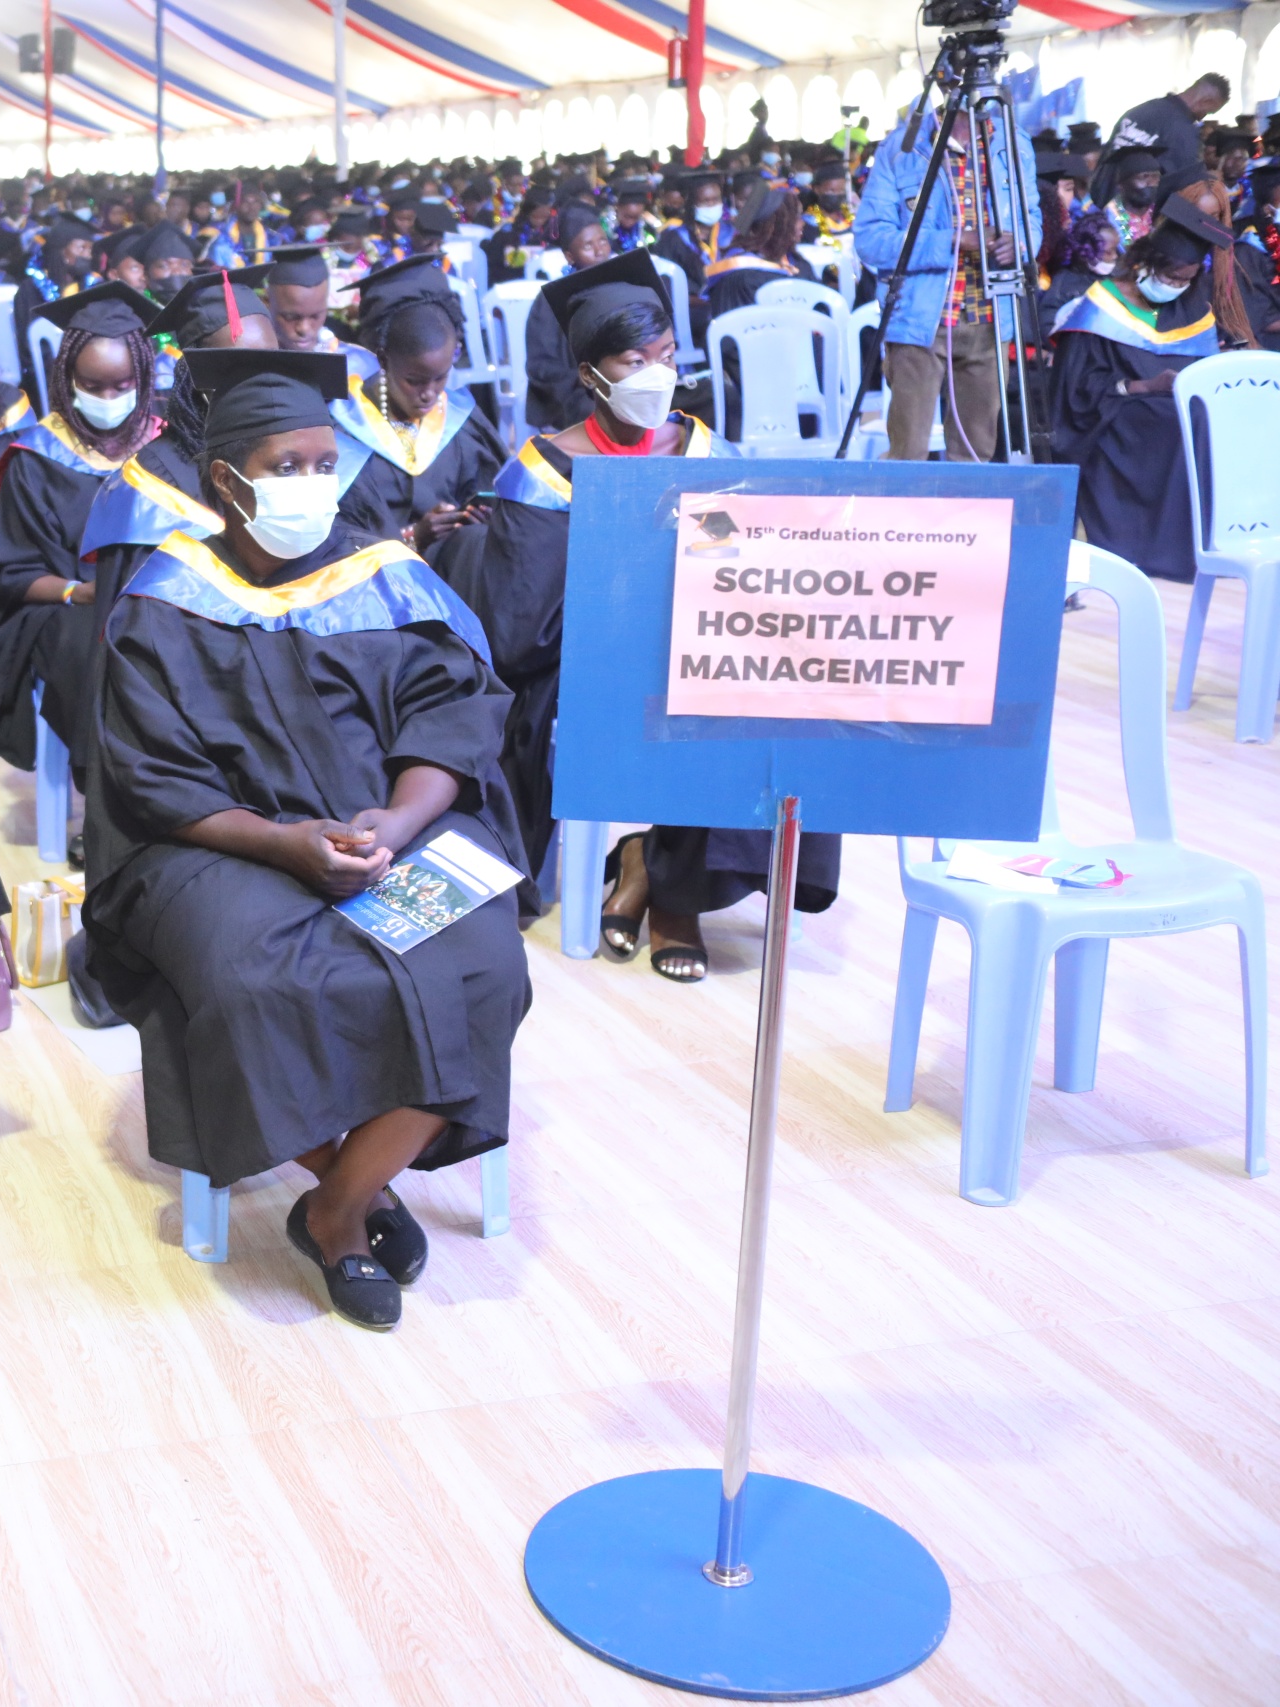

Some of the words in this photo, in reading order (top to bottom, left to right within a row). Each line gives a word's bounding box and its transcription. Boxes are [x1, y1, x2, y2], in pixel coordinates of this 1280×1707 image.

[745, 526, 775, 539] 15th
[778, 526, 881, 542] Graduation
[883, 529, 978, 547] Ceremony
[712, 566, 874, 597] SCHOOL
[882, 570, 938, 597] OF
[696, 610, 955, 642] HOSPITALITY
[678, 654, 965, 687] MANAGEMENT
